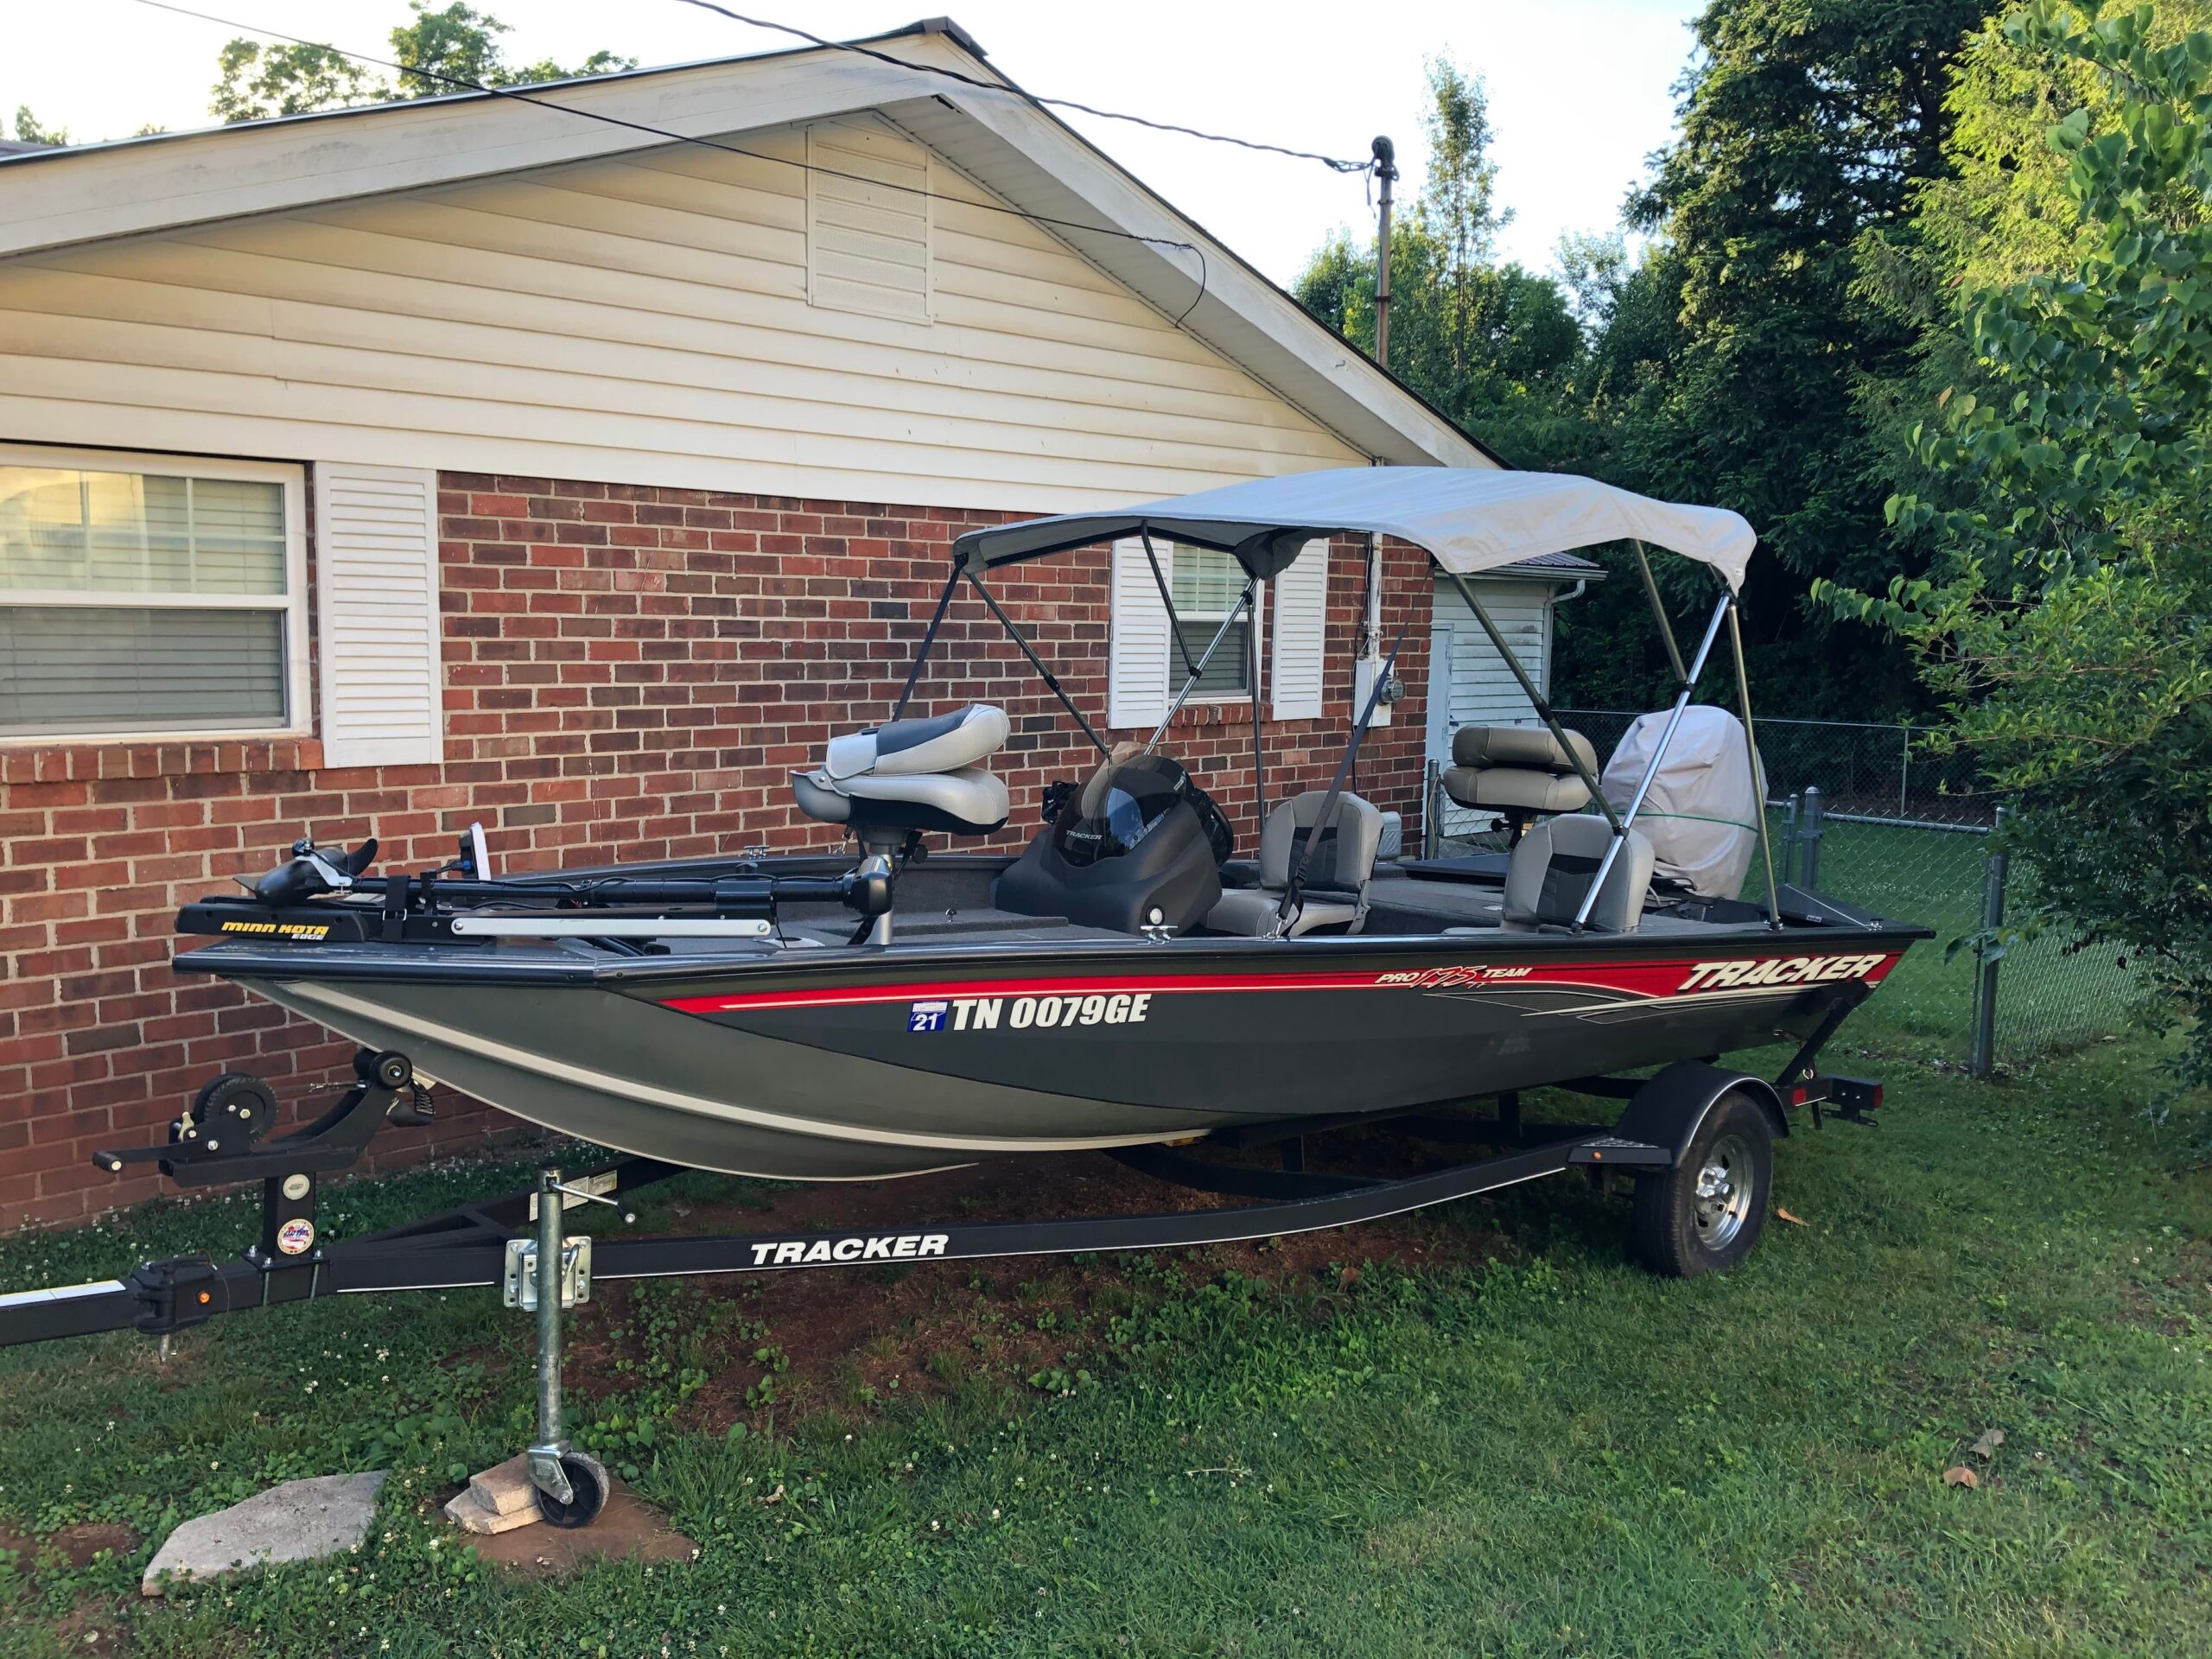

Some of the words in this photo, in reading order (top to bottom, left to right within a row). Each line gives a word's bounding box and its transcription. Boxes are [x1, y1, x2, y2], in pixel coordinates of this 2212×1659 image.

[1065, 830, 1103, 841] TRACKER
[221, 921, 276, 933] MINN
[277, 925, 329, 935] KOTA
[1375, 972, 1420, 984] PRO
[1409, 964, 1488, 989] 175
[1482, 967, 1534, 979] TEAM
[1676, 954, 1887, 991] TRACKER
[912, 1013, 938, 1031] 21
[952, 998, 1003, 1031] TN
[1009, 994, 1153, 1029] 0079GE
[750, 1234, 950, 1266] TRACKER
